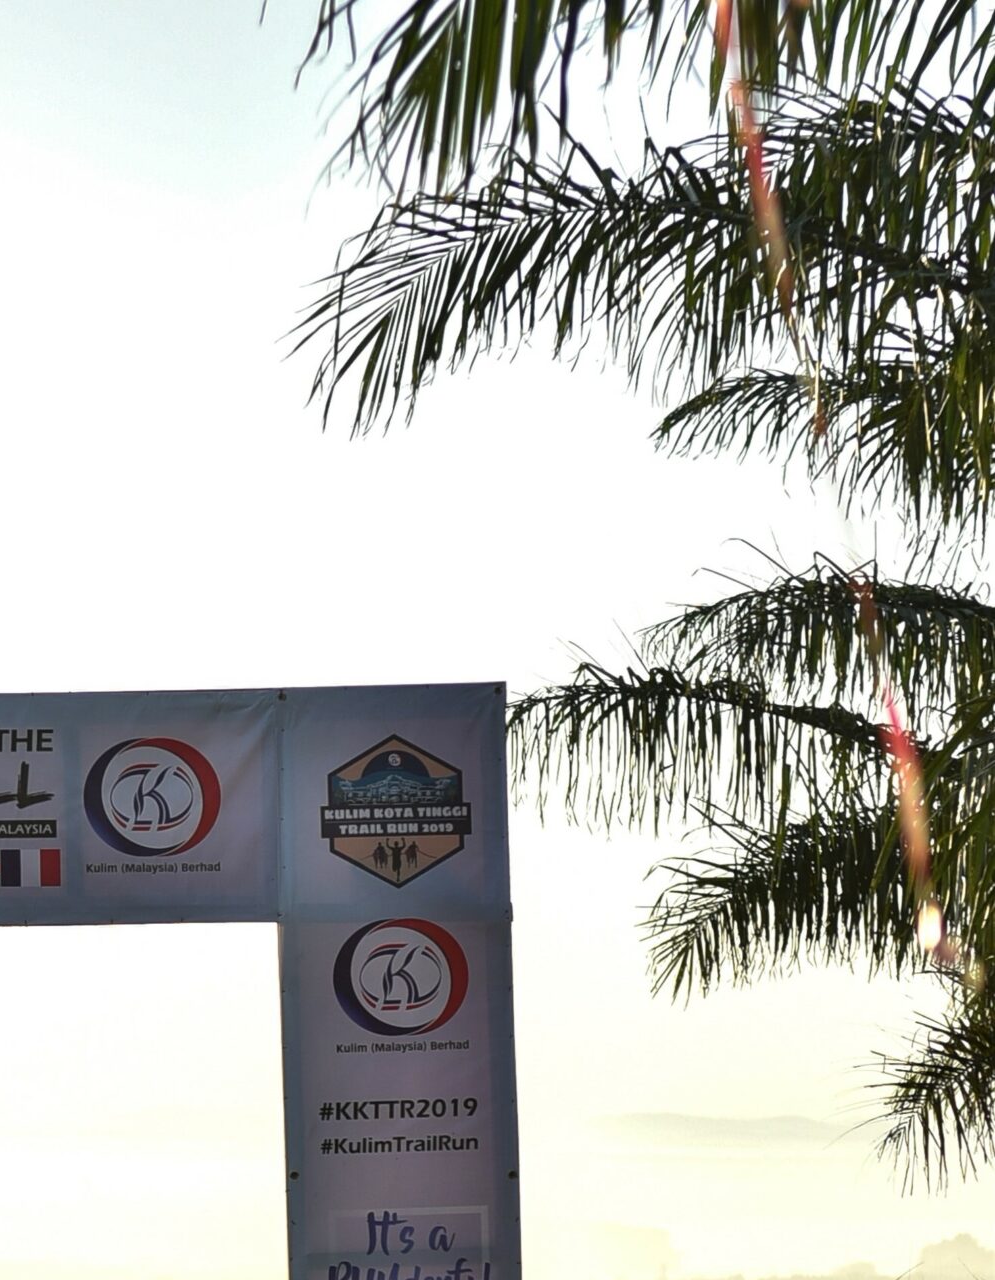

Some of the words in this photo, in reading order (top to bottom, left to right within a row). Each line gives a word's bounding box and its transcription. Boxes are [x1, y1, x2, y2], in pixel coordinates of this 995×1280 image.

[324, 809, 371, 820] KULIM
[374, 807, 413, 818] KOTA
[417, 806, 468, 817] TINGGI
[339, 824, 384, 835] TRAIL
[387, 823, 418, 834] RUN
[422, 823, 454, 832] 2019
[86, 863, 118, 873] Kulim
[121, 862, 178, 875] (Malaysia)
[181, 861, 221, 873] Berhad
[336, 1043, 368, 1054] Kulim
[371, 1042, 427, 1054] (Malaysia)
[430, 1040, 470, 1051] Berhad
[319, 1098, 478, 1121] #KKTTR2019
[320, 1135, 479, 1155] #KulimTrailRun
[366, 1211, 415, 1256] It's
[429, 1226, 456, 1252] a
